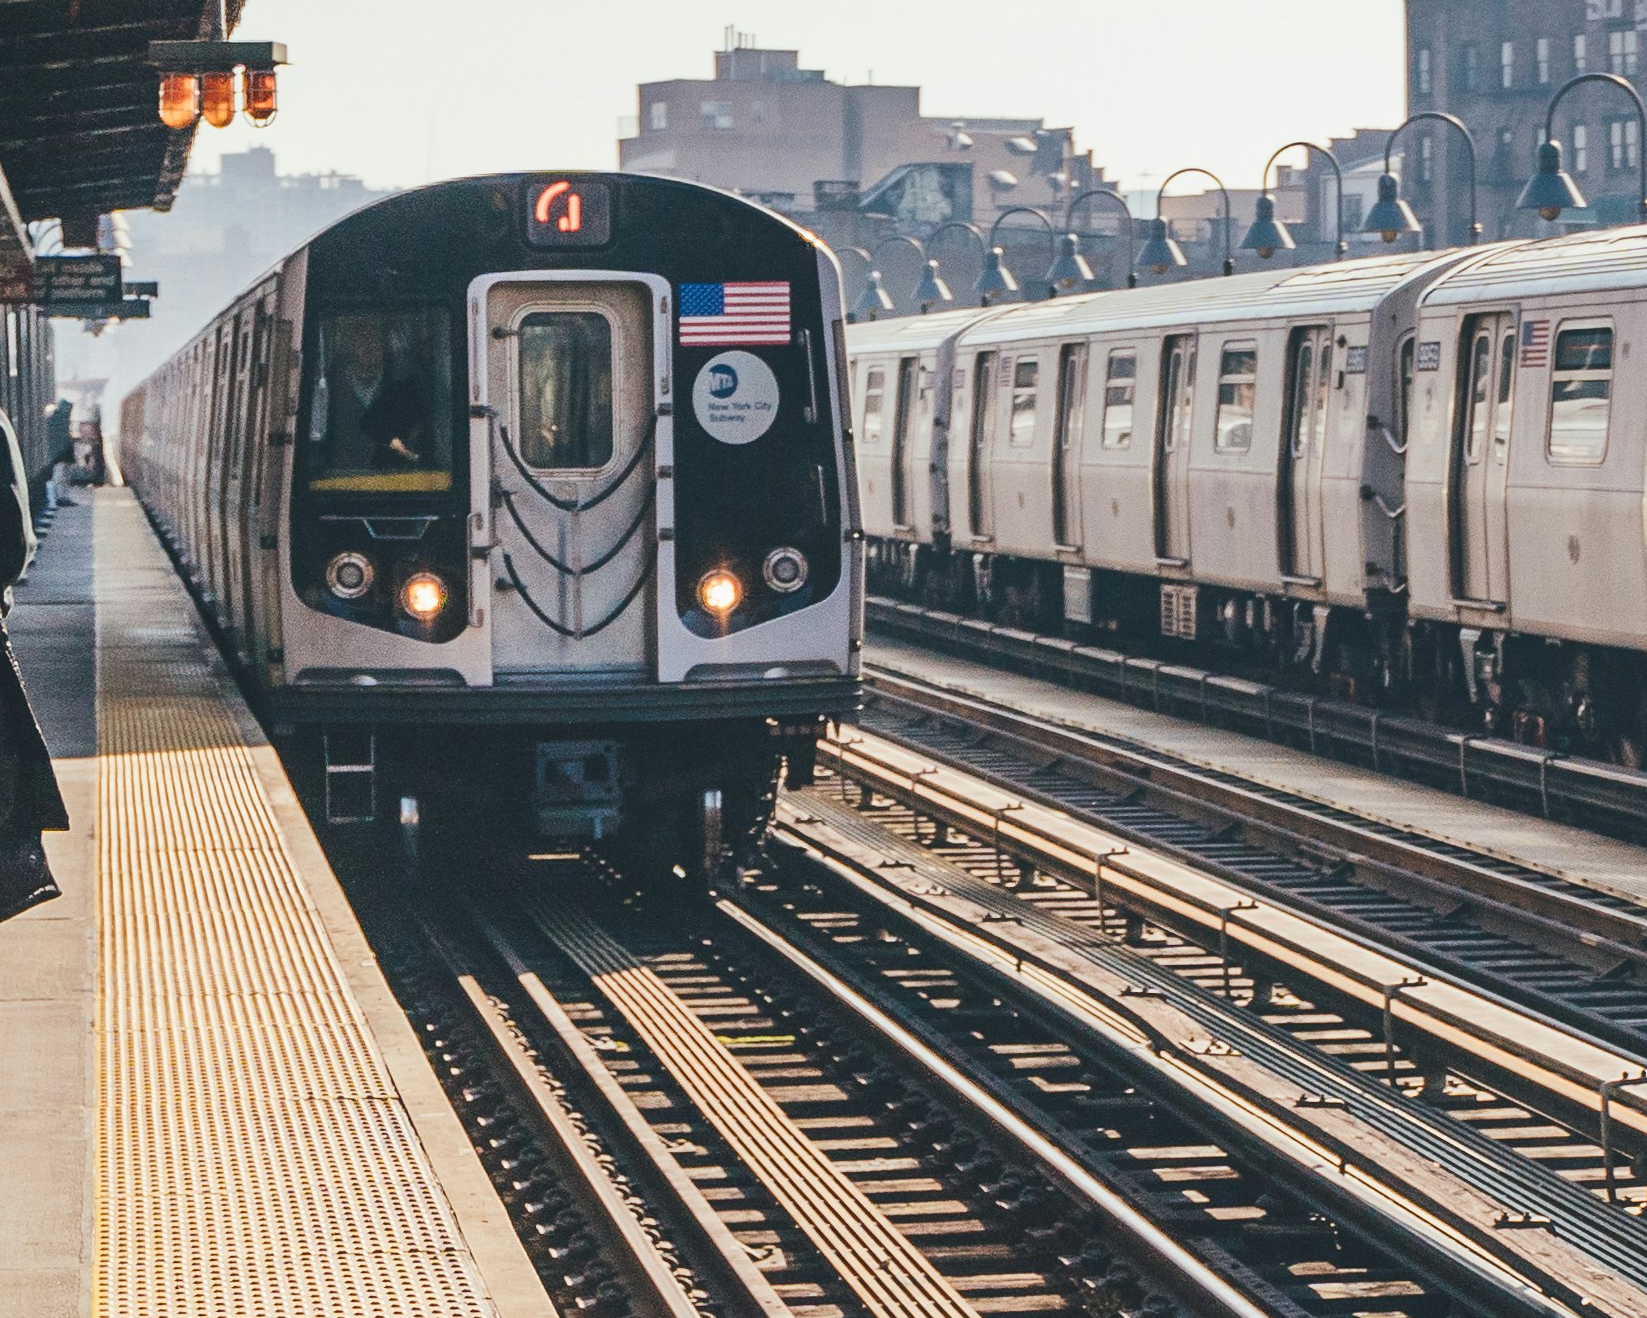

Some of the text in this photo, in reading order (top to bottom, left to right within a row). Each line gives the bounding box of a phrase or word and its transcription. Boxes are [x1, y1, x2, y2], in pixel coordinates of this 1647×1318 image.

[708, 402, 772, 412] New York City
[708, 413, 746, 423] Subway
